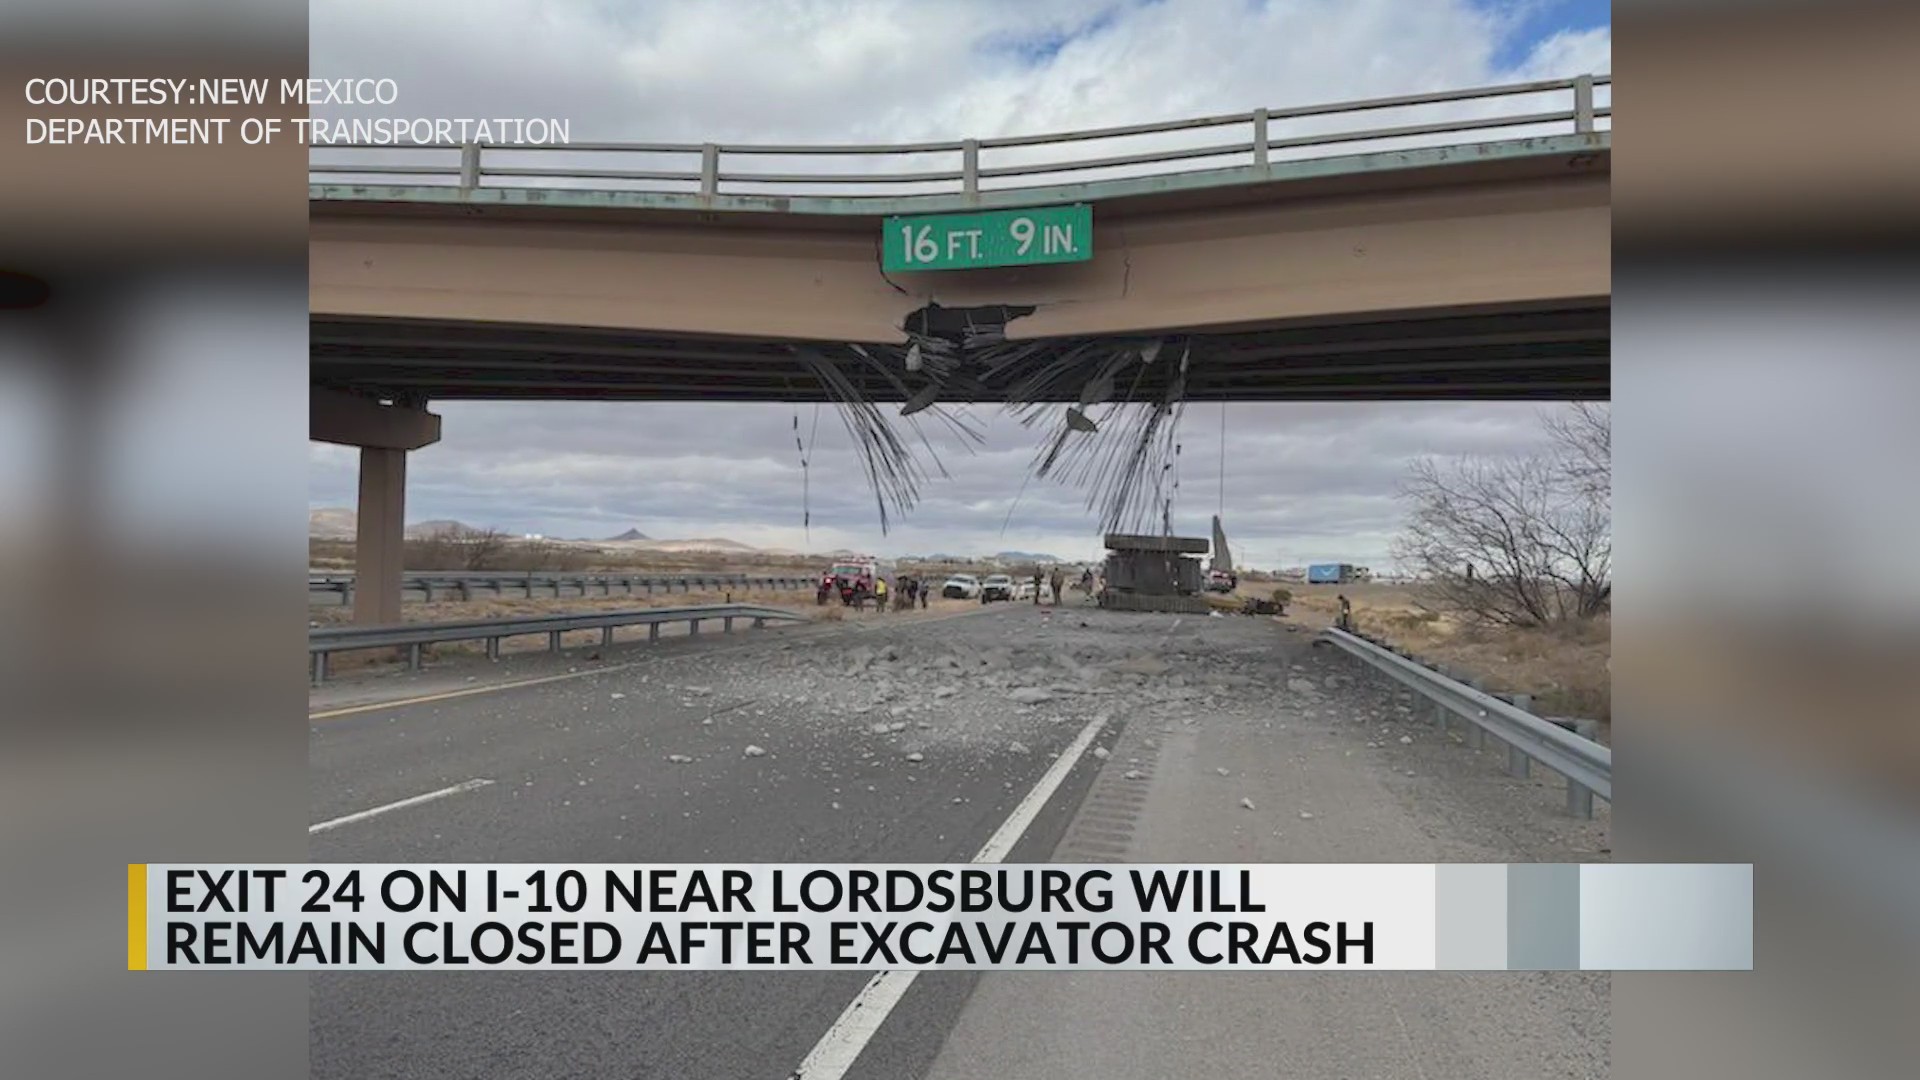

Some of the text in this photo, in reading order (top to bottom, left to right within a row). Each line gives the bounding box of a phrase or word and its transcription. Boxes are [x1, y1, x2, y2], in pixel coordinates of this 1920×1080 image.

[901, 217, 1078, 263] 16 FT. 9 IN.
